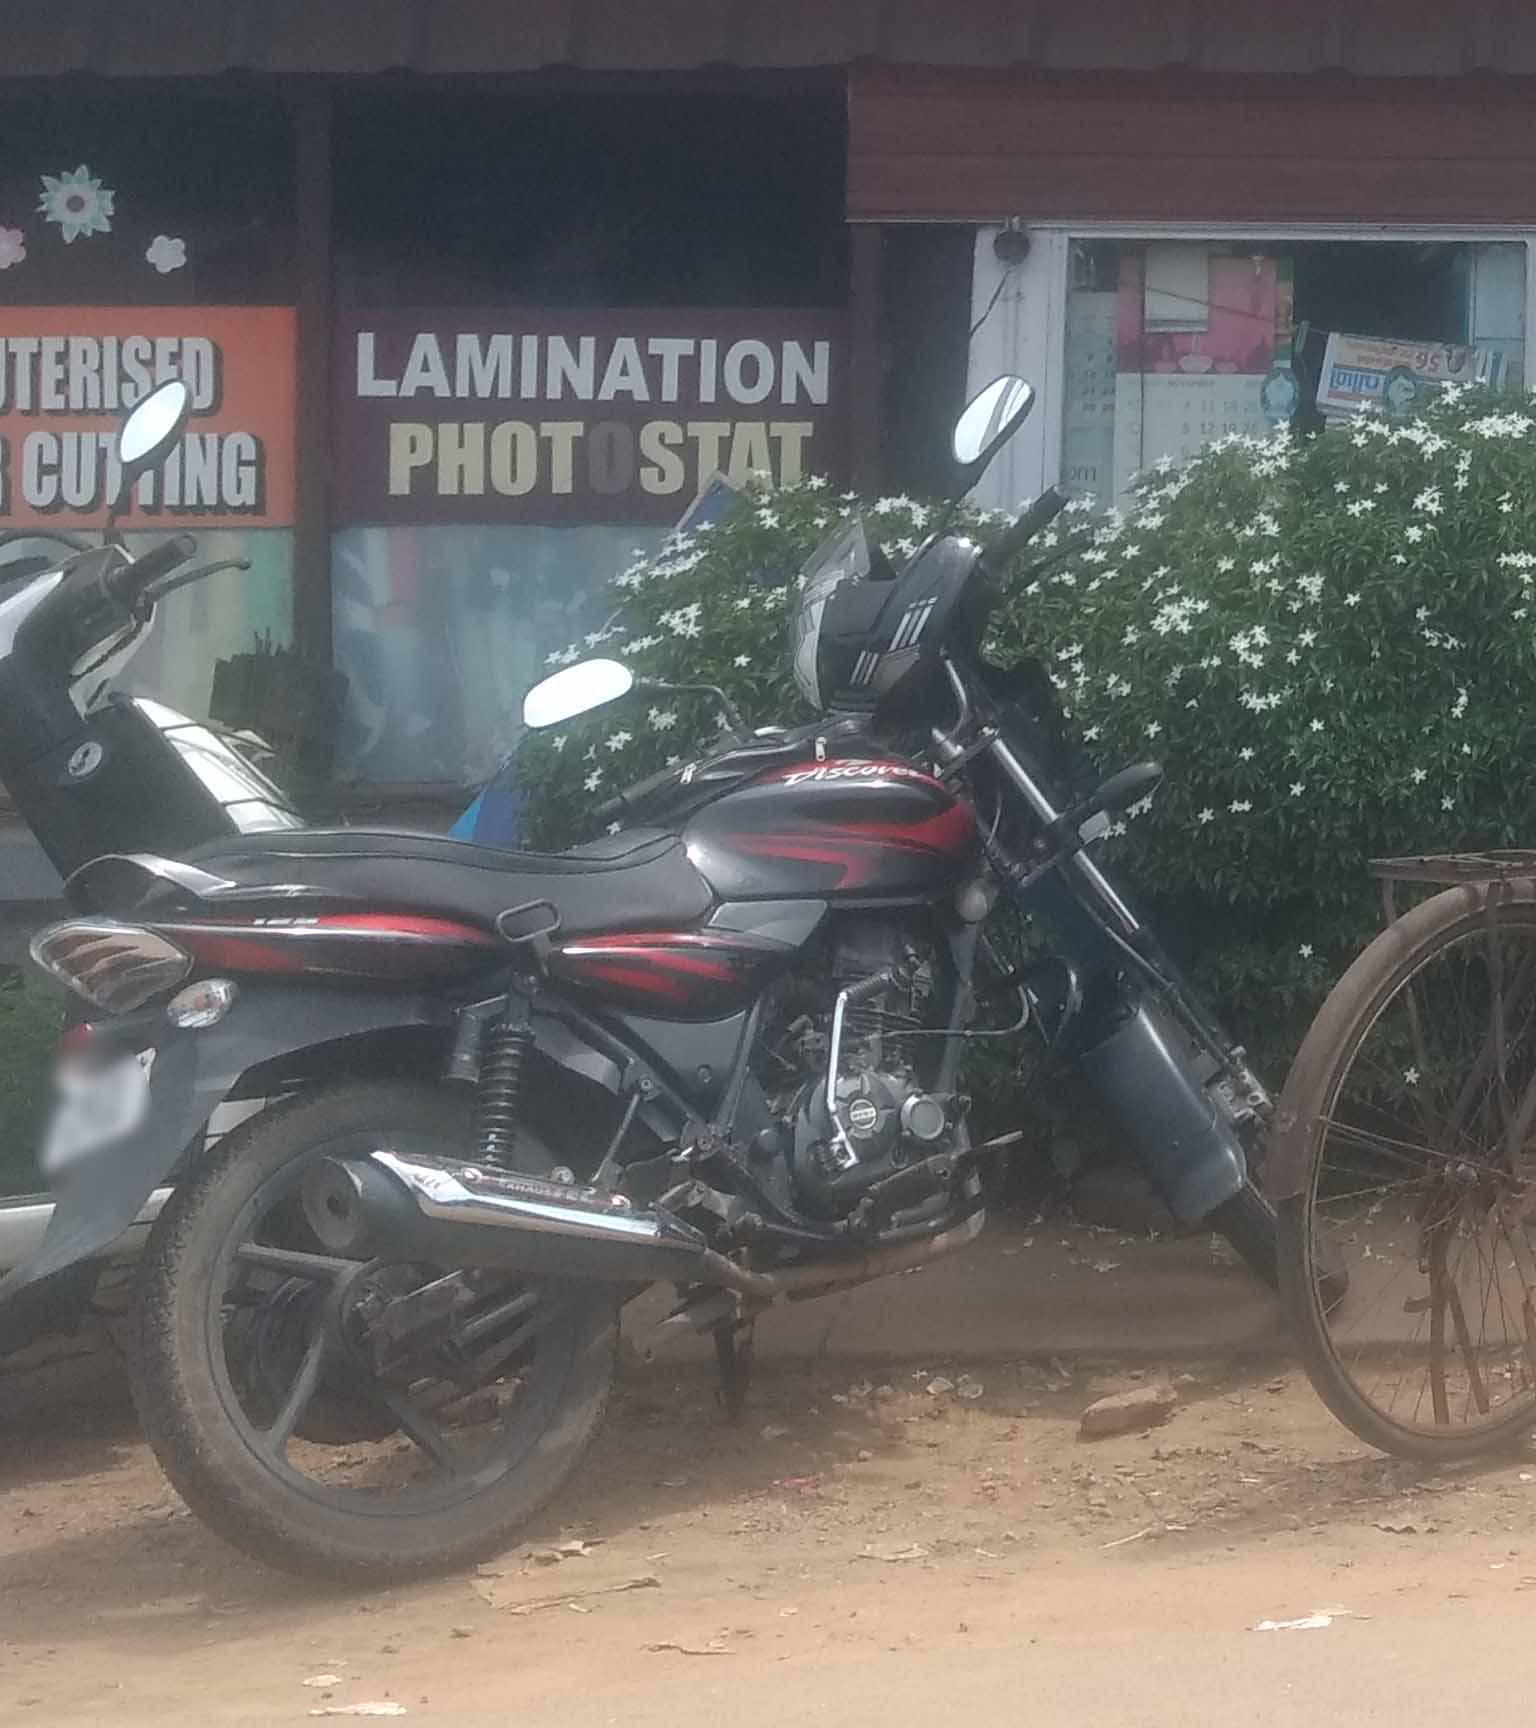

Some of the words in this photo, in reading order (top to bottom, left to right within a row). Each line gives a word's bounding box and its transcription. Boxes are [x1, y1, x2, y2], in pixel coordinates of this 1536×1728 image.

[357, 331, 831, 405] LAMINATION
[22, 431, 257, 507] CUTING
[388, 420, 814, 497] PHOTOSTAT
